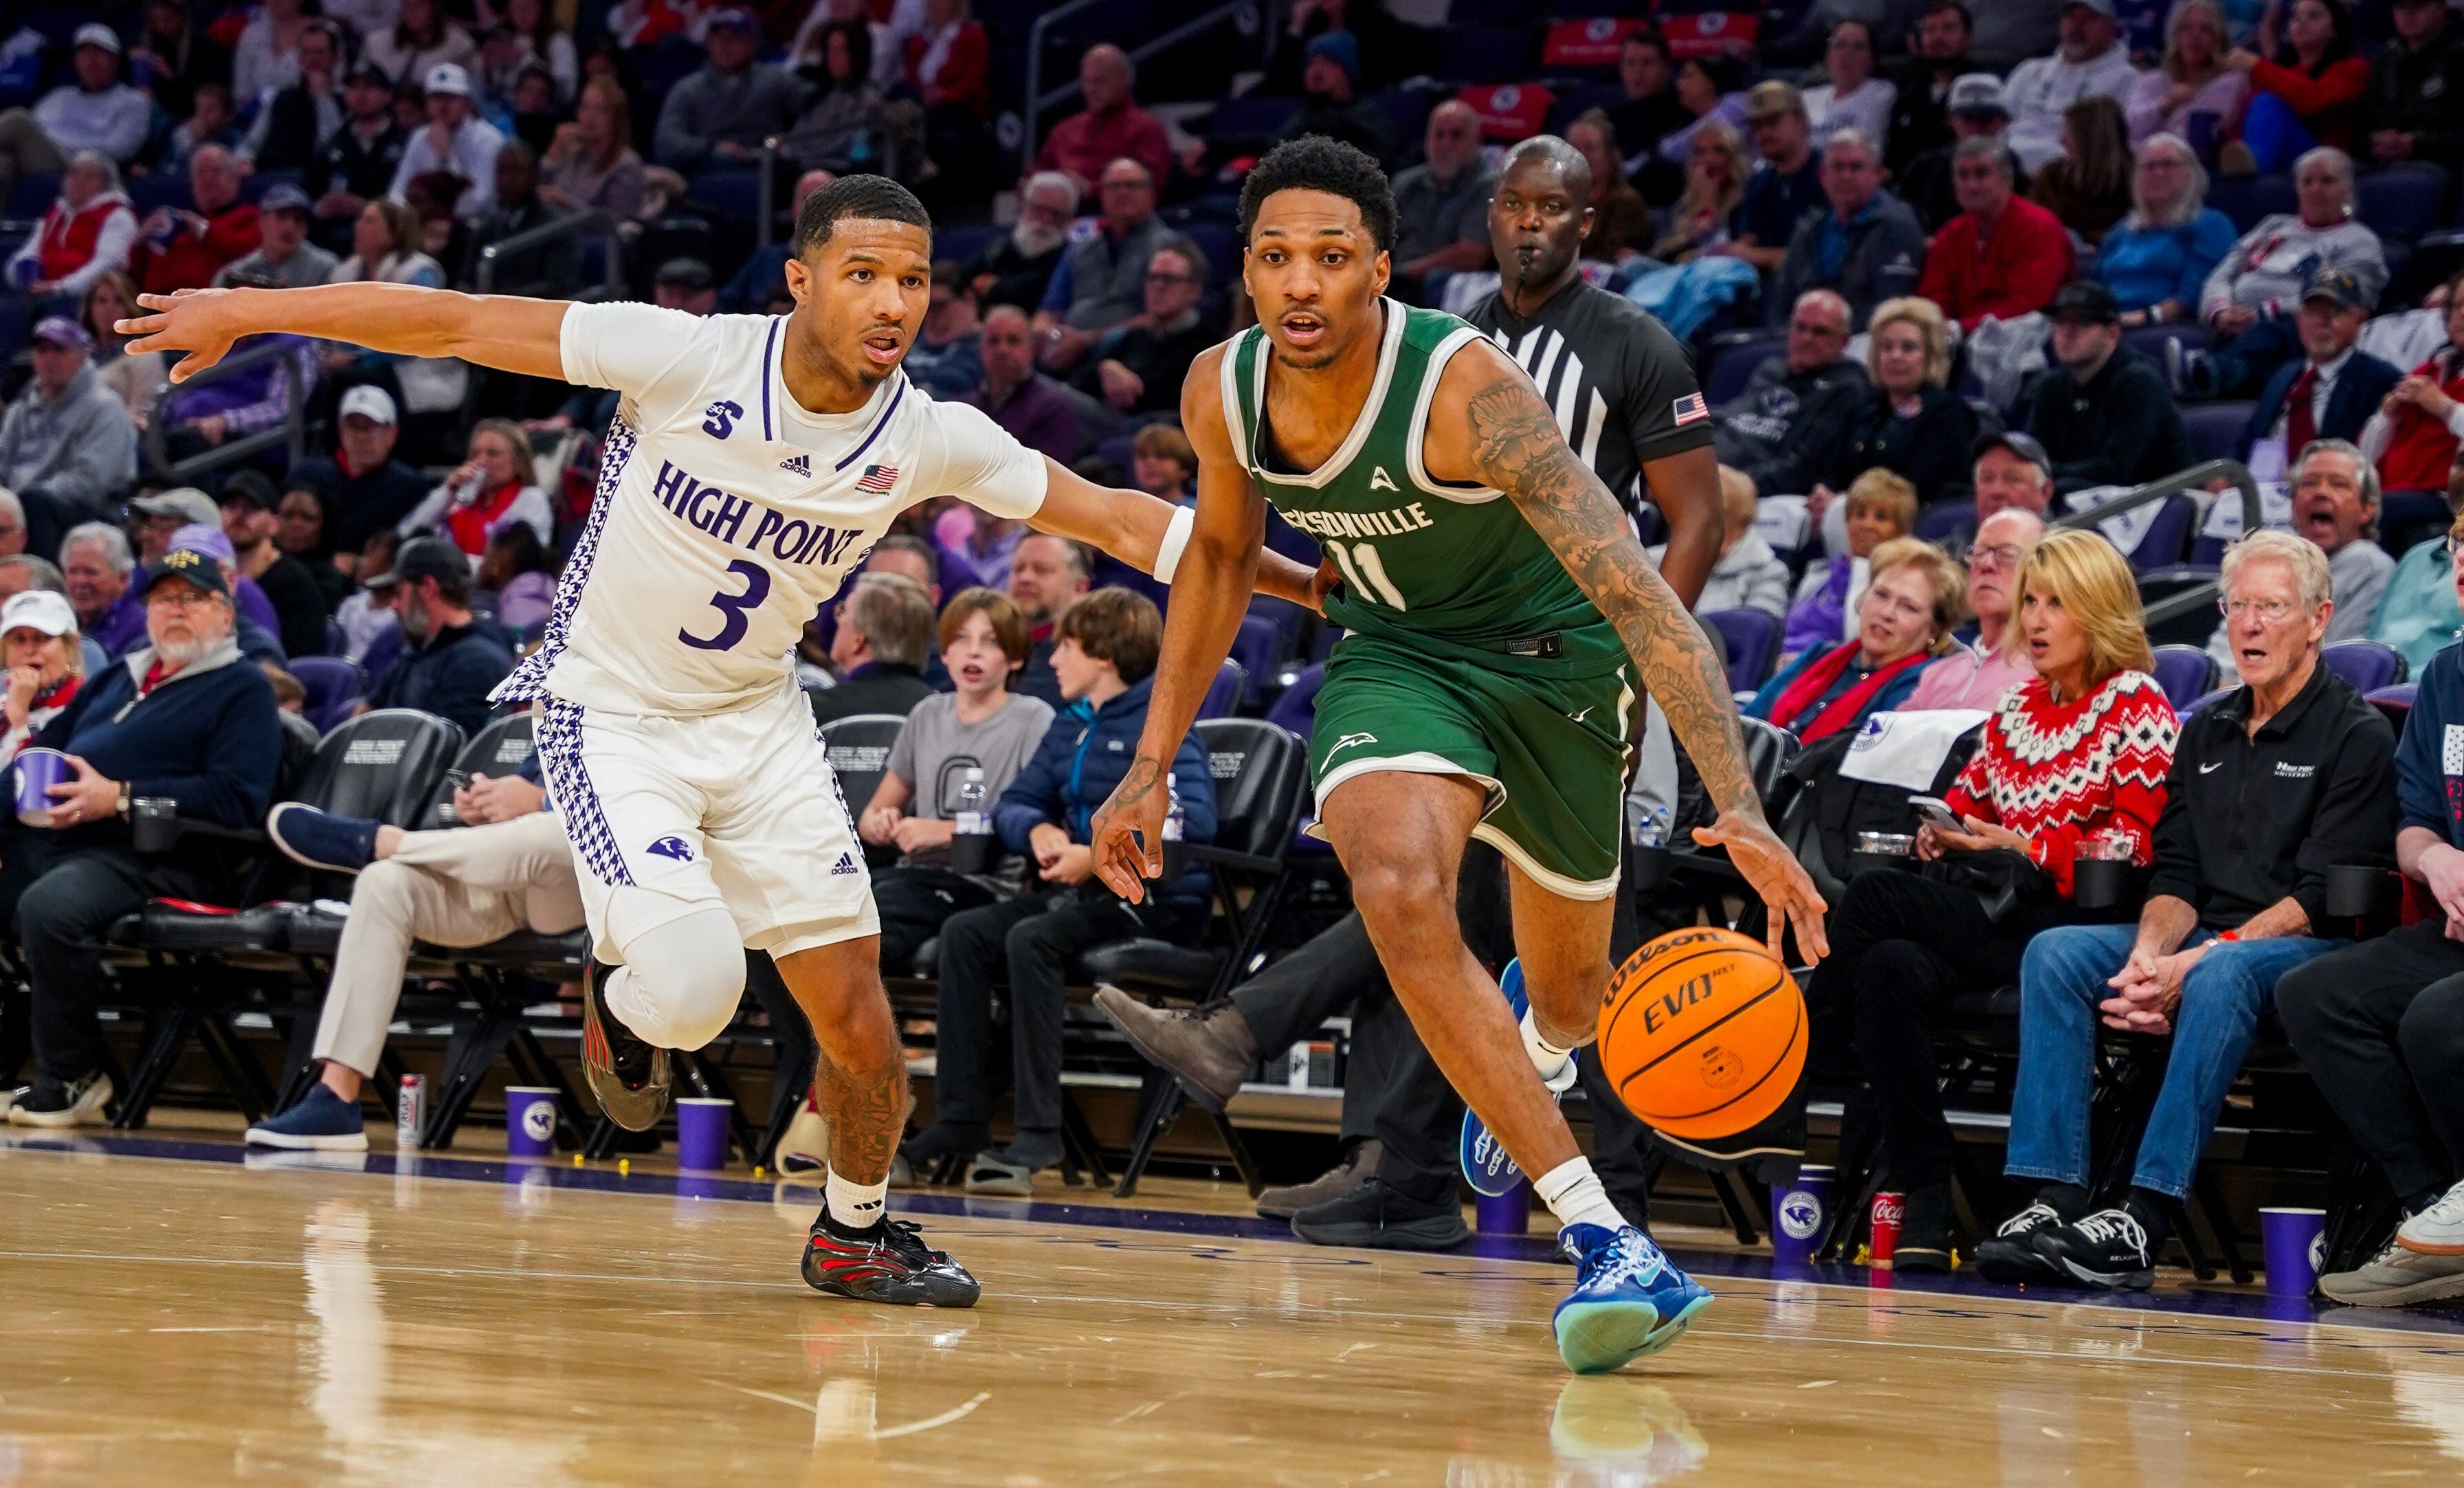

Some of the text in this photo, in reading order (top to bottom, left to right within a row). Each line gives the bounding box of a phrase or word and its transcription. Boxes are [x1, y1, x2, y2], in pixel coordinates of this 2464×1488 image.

[779, 461, 812, 478] adidas
[652, 458, 865, 566] HIGH POINT
[1276, 501, 1434, 538] CKSONVILLE
[1326, 539, 1406, 612] 11
[678, 559, 771, 652] 3
[1547, 642, 1553, 652] L
[832, 866, 858, 875] adidas
[1643, 973, 1713, 1035] EVO
